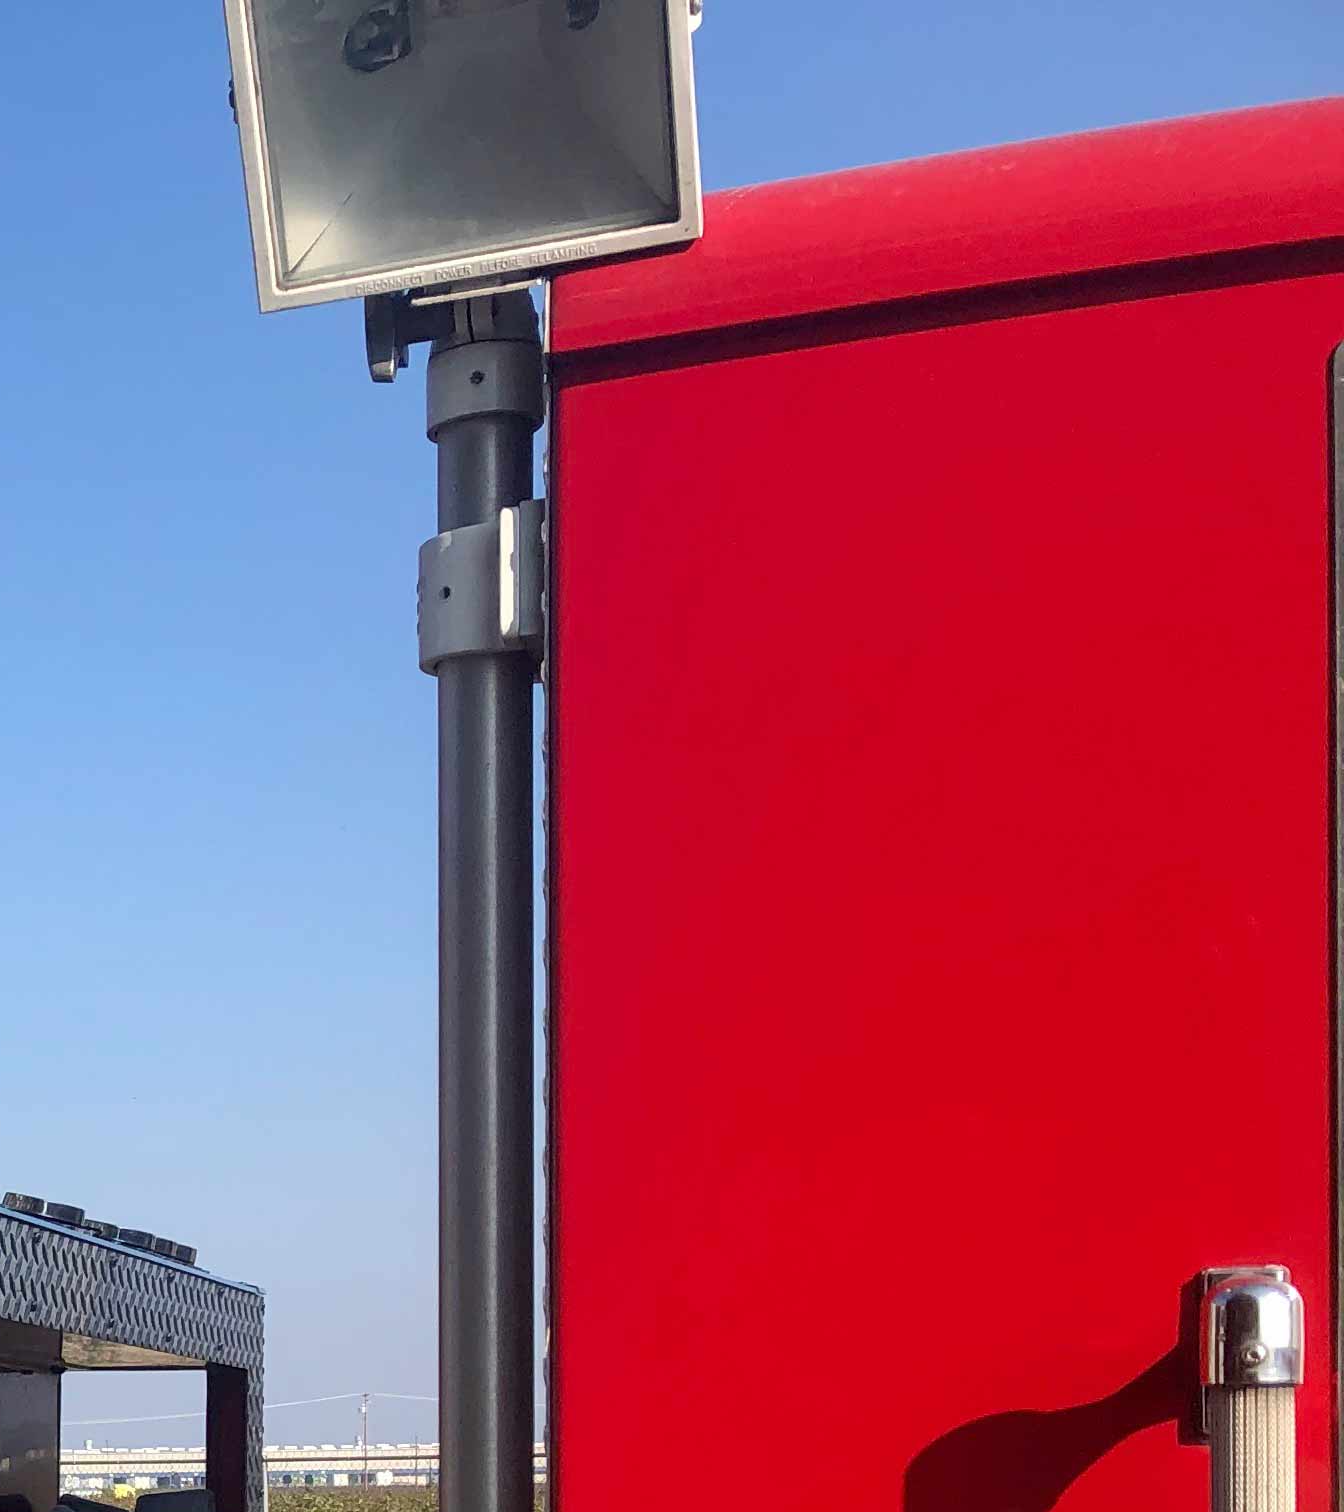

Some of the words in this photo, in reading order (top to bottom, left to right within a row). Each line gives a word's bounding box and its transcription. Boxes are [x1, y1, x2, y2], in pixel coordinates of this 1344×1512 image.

[354, 272, 424, 295] DISCONNECT
[434, 264, 472, 281] POWER
[479, 255, 521, 272] BEFORE
[529, 242, 598, 265] RELAMPING
